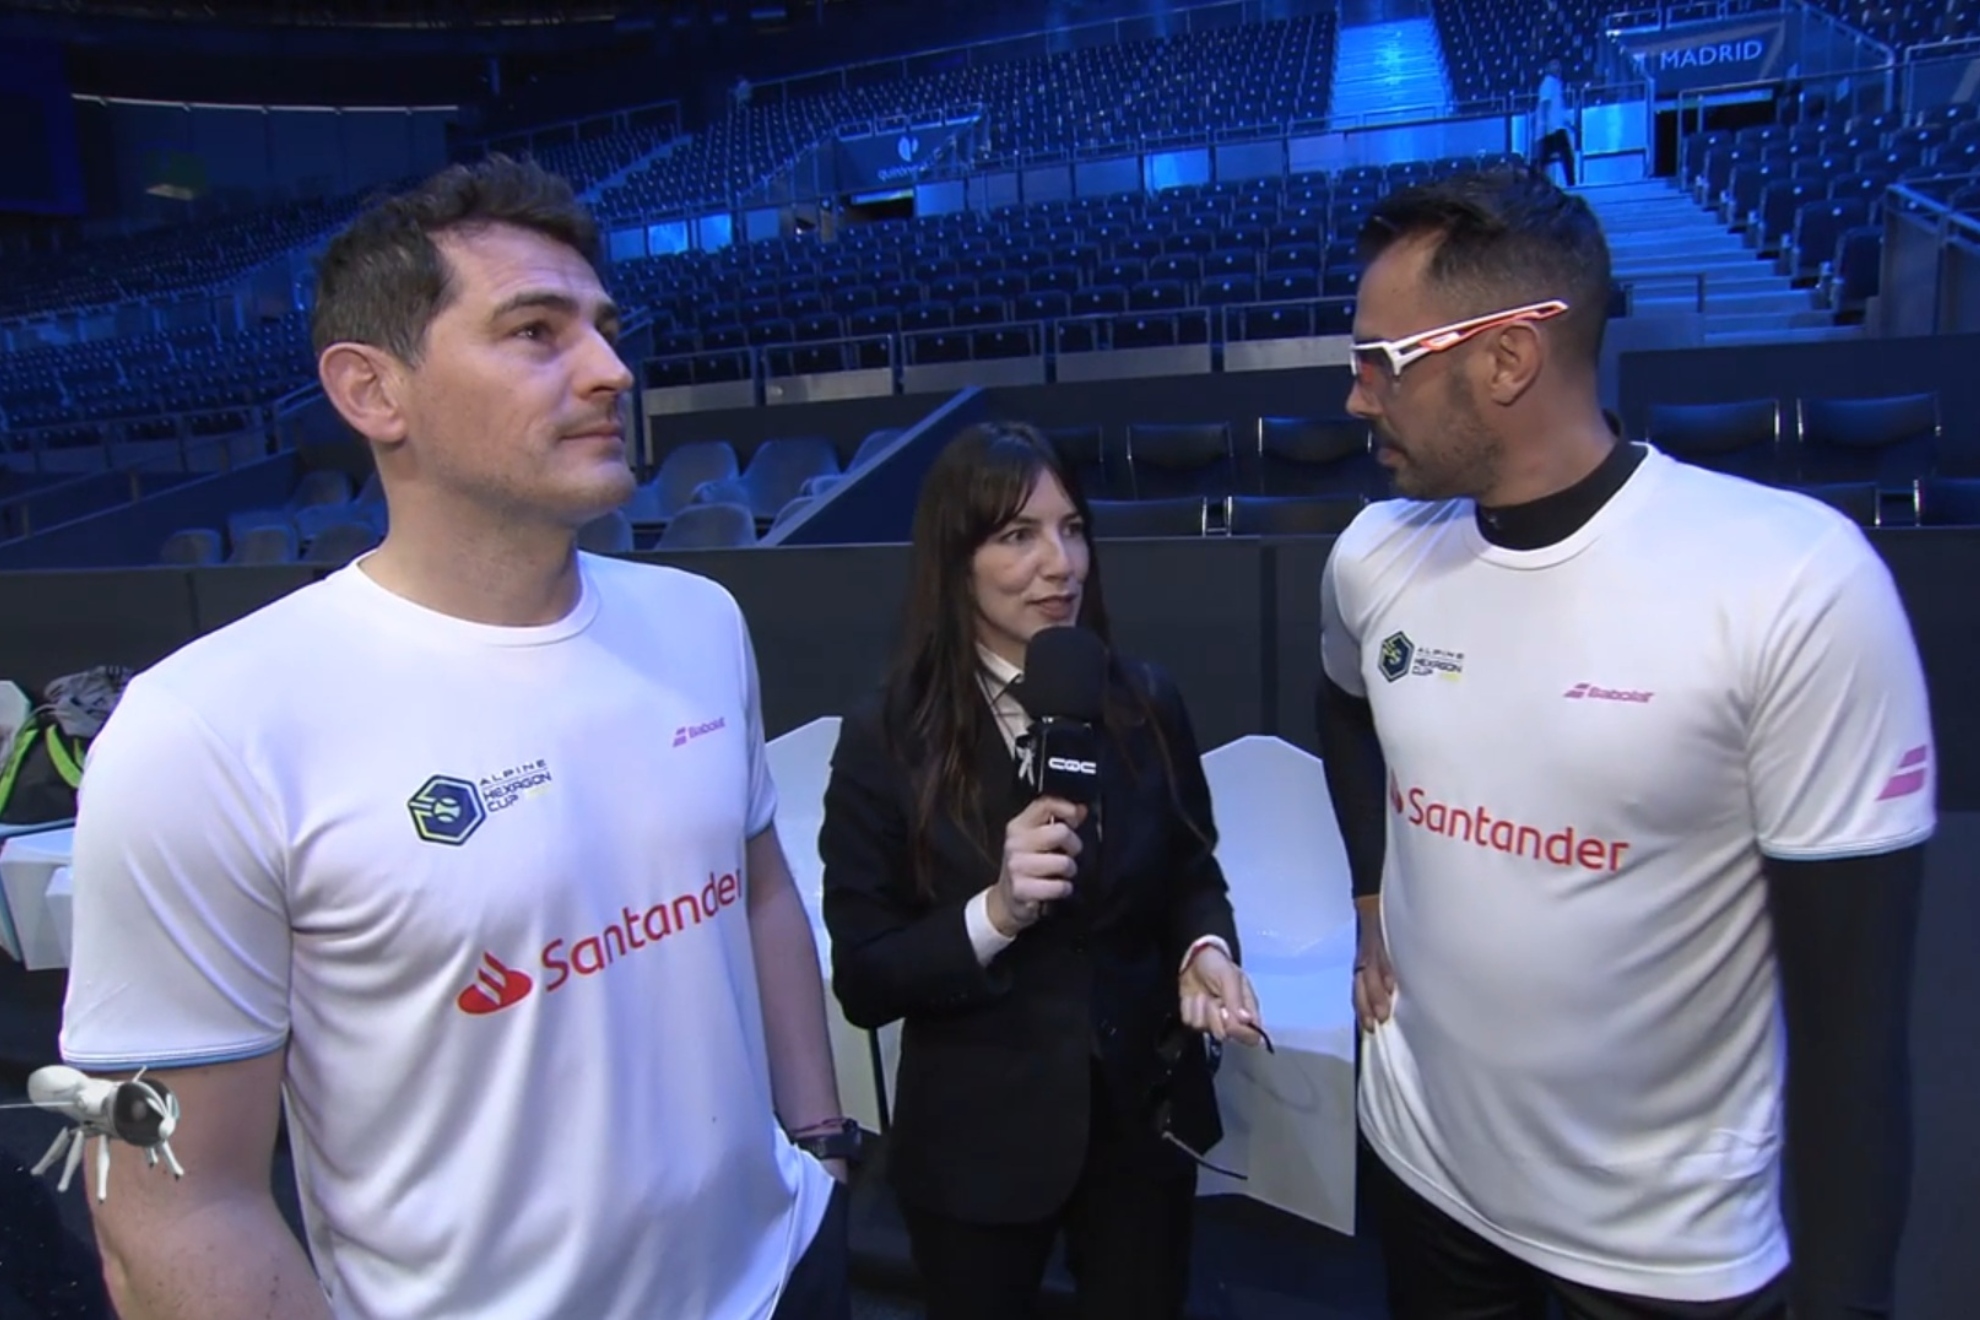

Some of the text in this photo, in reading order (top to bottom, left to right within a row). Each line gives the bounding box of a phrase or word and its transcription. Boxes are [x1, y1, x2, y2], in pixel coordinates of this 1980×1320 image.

[1660, 40, 1763, 70] MADRID
[479, 759, 546, 786] ALPINE
[482, 771, 553, 801] HEXAGON
[486, 793, 519, 813] CUP
[1408, 787, 1631, 872] Santander
